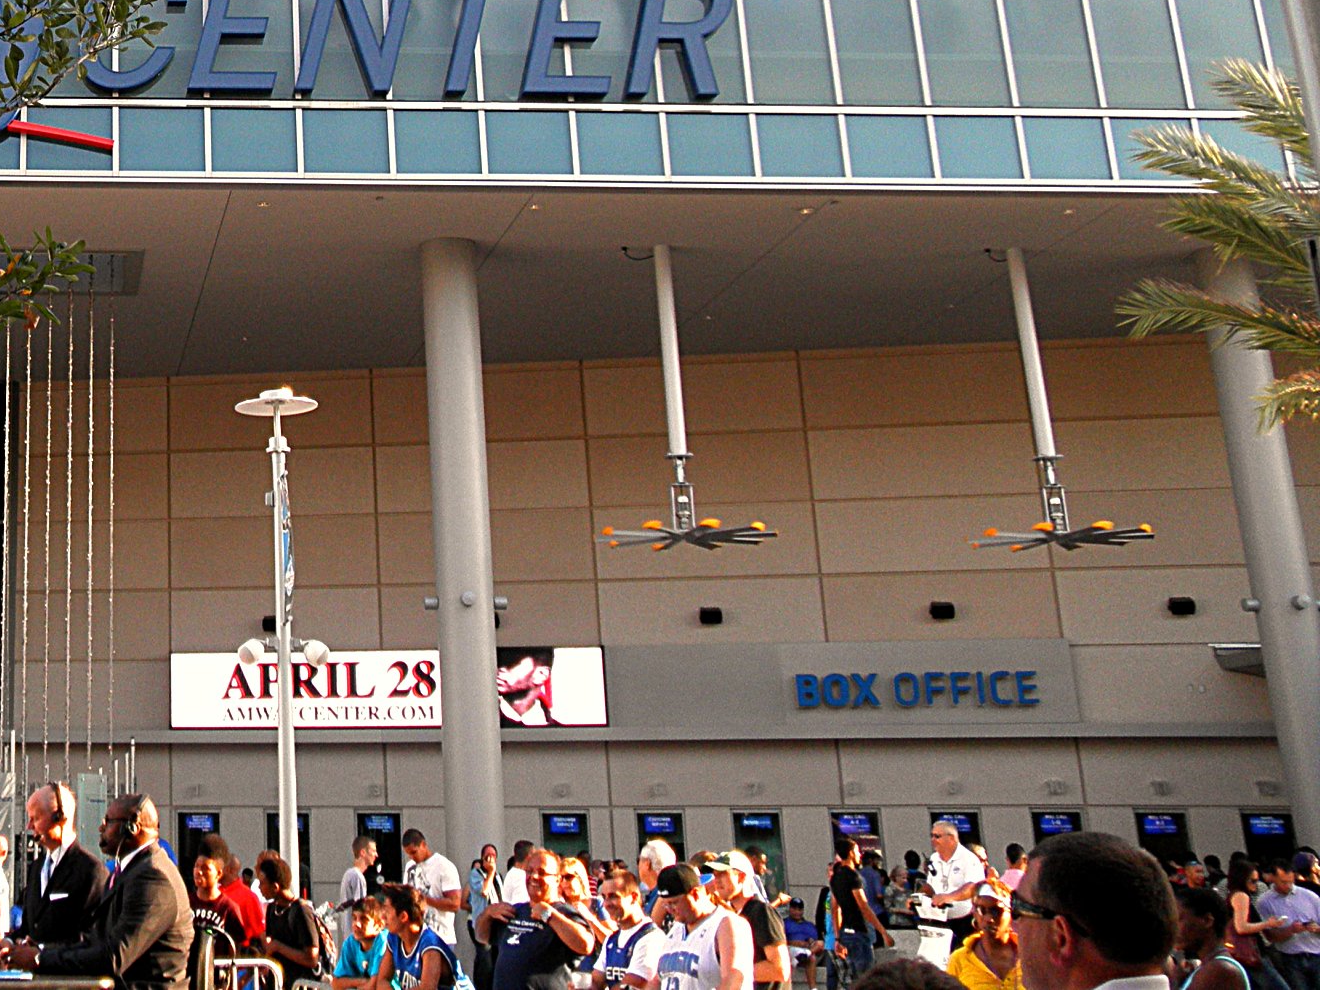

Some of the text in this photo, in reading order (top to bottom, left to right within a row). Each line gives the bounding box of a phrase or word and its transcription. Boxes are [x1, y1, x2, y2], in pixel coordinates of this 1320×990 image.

[222, 660, 436, 699] APRIL 28
[795, 671, 1040, 707] BOX OFFICE
[223, 706, 434, 721] AMWCENTER.COM
